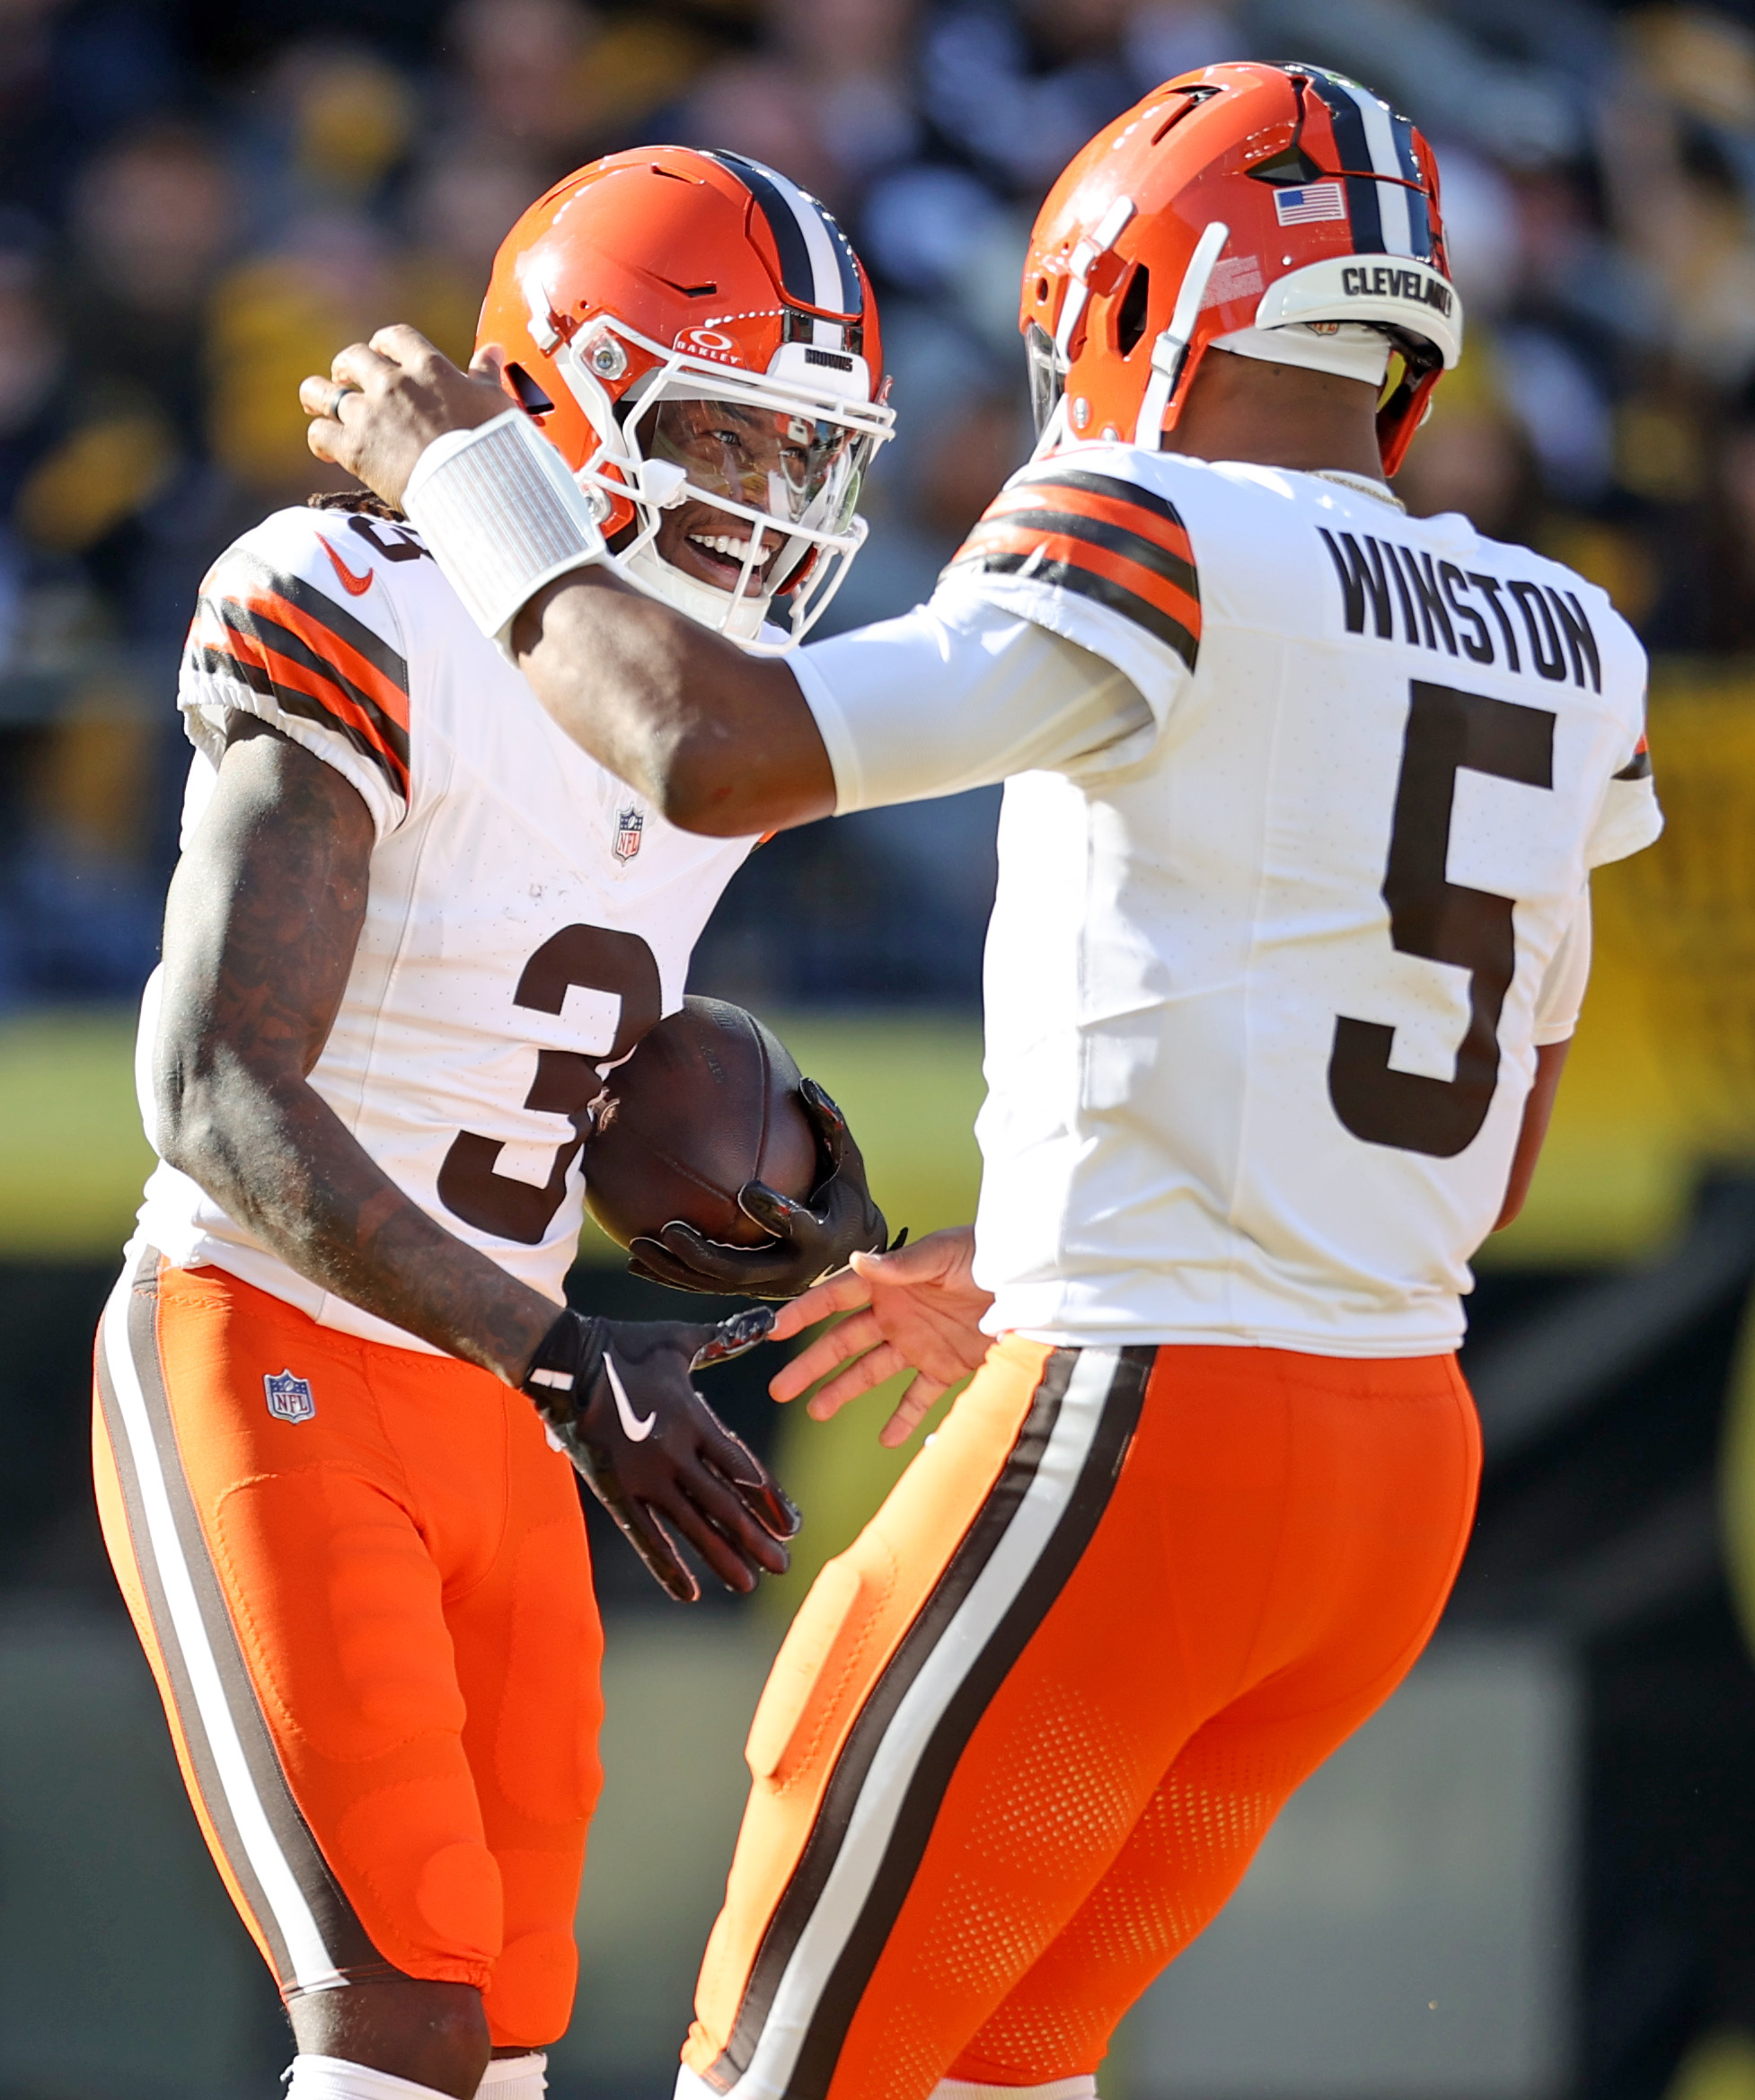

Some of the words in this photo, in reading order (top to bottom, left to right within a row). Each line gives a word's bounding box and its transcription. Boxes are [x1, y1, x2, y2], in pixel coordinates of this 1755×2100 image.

[1341, 267, 1452, 319] CLEVELAND
[676, 340, 740, 365] OAKLEY
[805, 348, 853, 373] BROWNS
[1317, 525, 1601, 694] WINSTON
[617, 832, 638, 854] NFL
[1327, 678, 1557, 1160] 5
[437, 922, 663, 1246] 3
[275, 1394, 308, 1414] NFL
